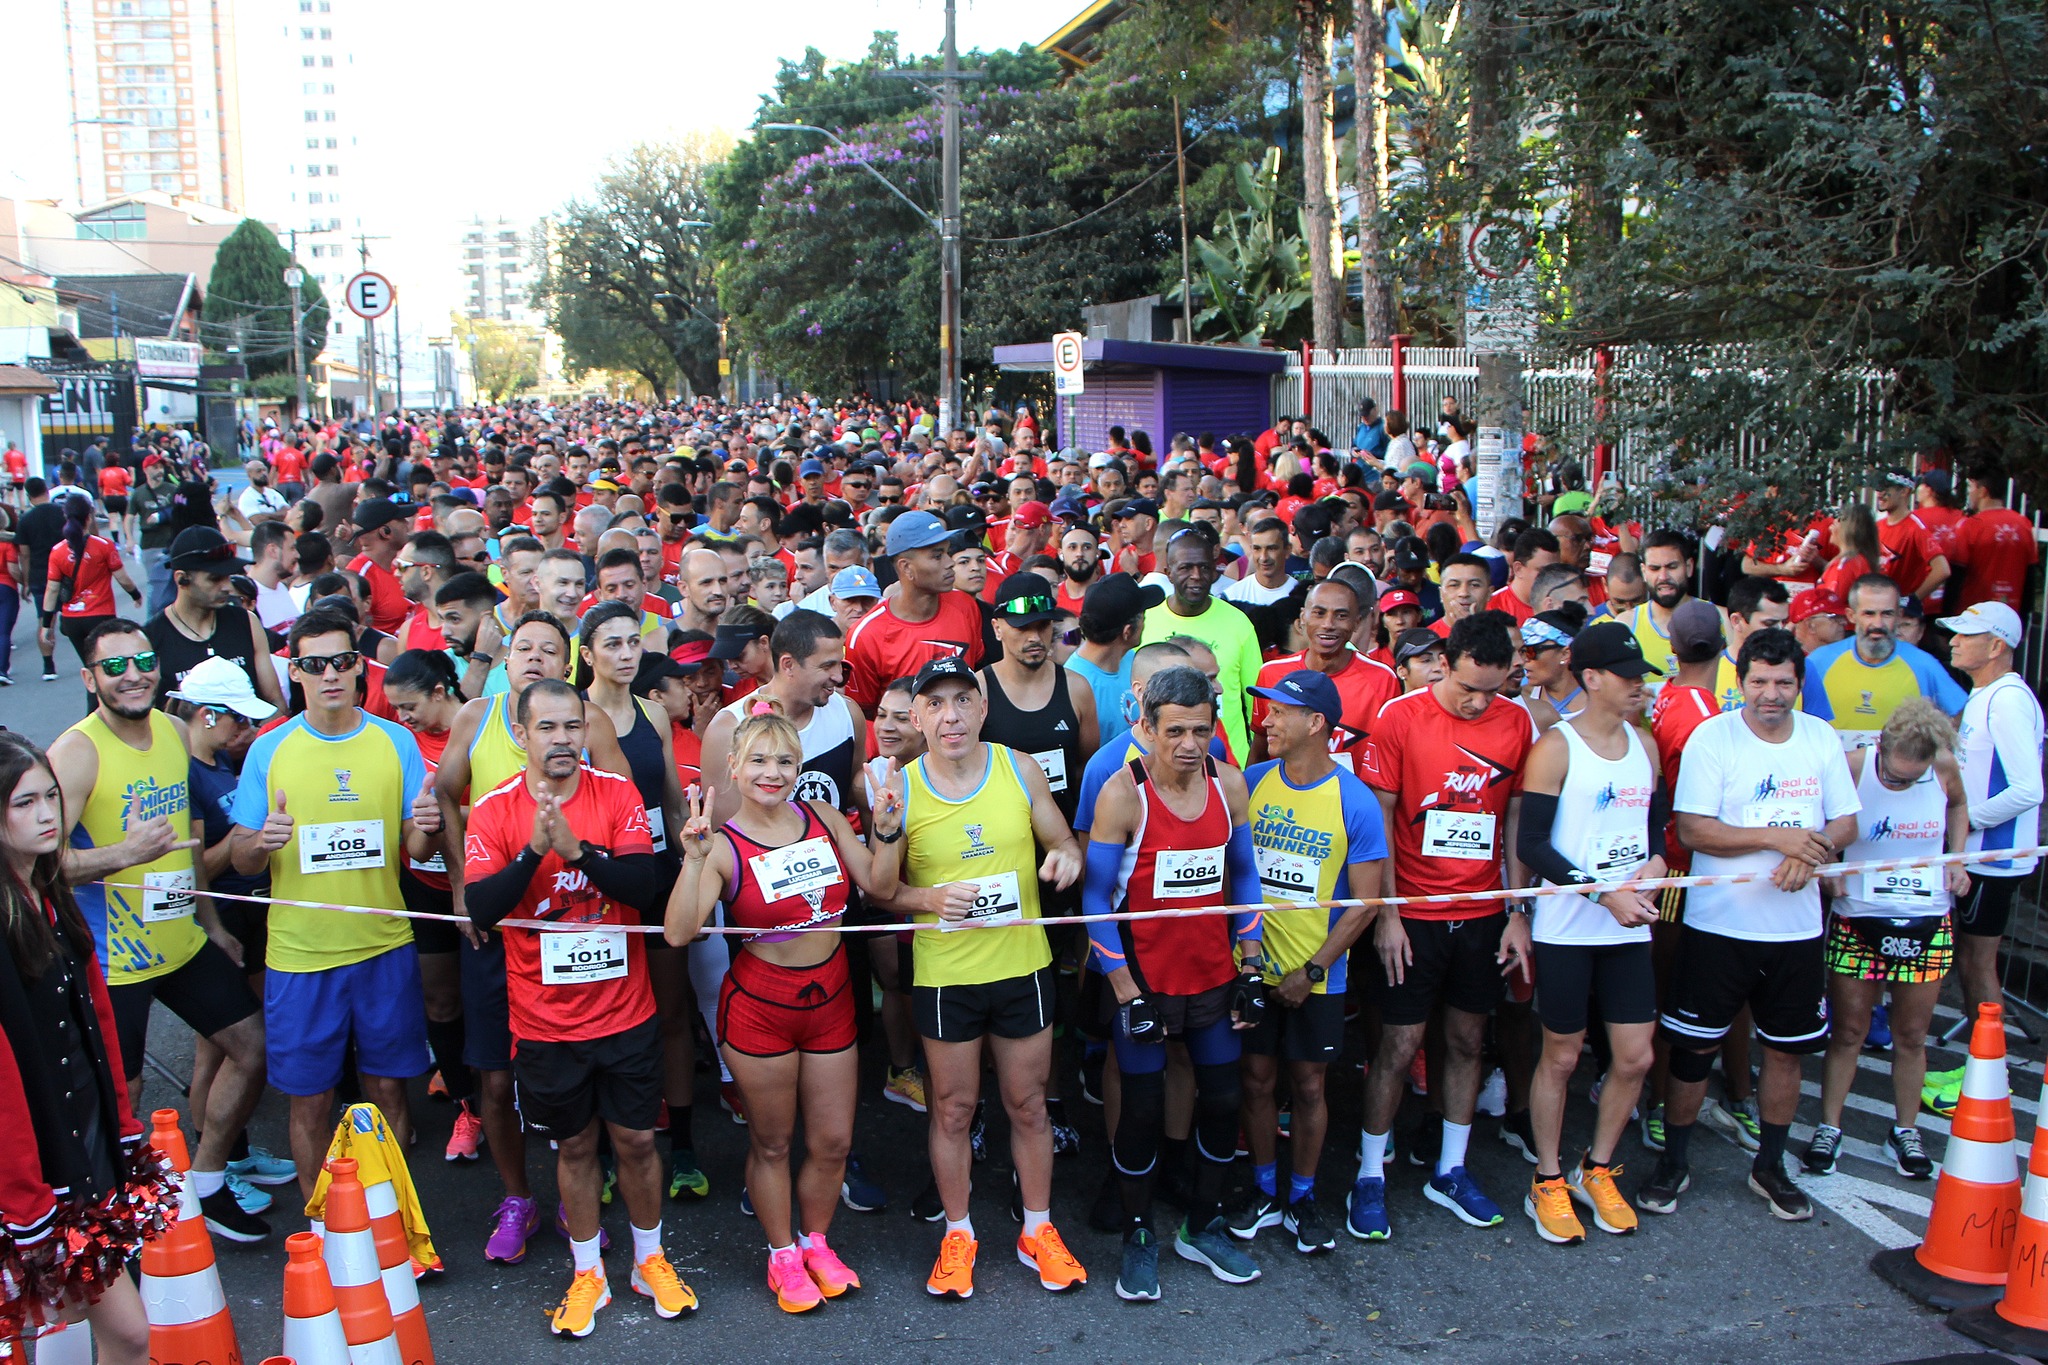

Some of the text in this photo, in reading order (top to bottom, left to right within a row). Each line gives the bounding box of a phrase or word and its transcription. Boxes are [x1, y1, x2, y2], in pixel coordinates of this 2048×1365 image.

[361, 281, 377, 308] E
[1063, 343, 1073, 364] E
[1443, 771, 1488, 792] RUN
[1447, 829, 1481, 841] 740
[327, 838, 366, 851] 108
[1253, 833, 1332, 859] RUNNERS
[1608, 844, 1639, 860] 902
[325, 851, 367, 860] ANDERSON
[784, 857, 821, 876] 106
[1174, 865, 1217, 879] 1084
[1267, 867, 1304, 883] 1110
[1886, 877, 1922, 888] 909
[970, 893, 1002, 909] 07
[971, 908, 998, 917] CELSO
[567, 948, 611, 963] 1011
[571, 962, 608, 972] RODRIGO
